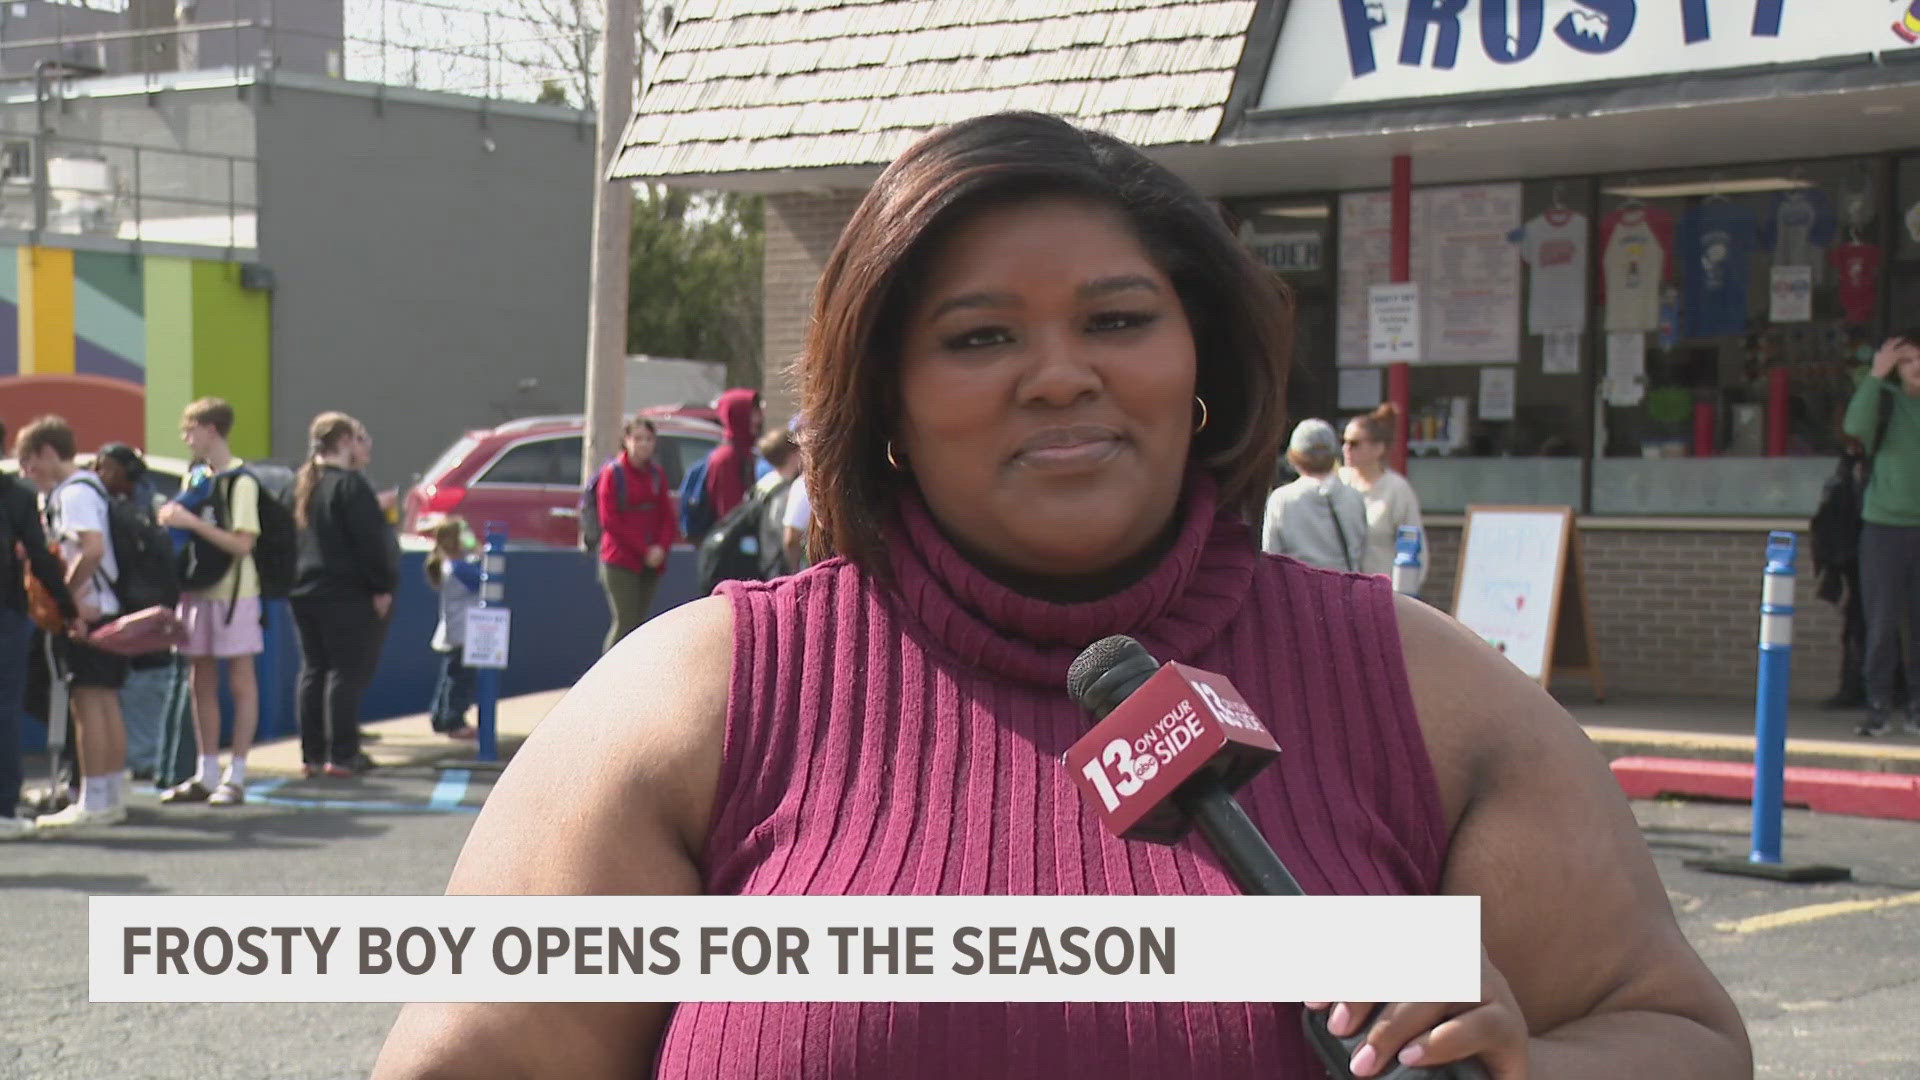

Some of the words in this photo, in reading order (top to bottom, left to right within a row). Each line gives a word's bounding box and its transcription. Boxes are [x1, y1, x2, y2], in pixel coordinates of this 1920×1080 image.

[1135, 730, 1158, 754] ON
[1155, 699, 1193, 734] YOUR
[1154, 711, 1205, 766] SIDE
[1081, 738, 1145, 814] 13
[1136, 757, 1157, 777] abc
